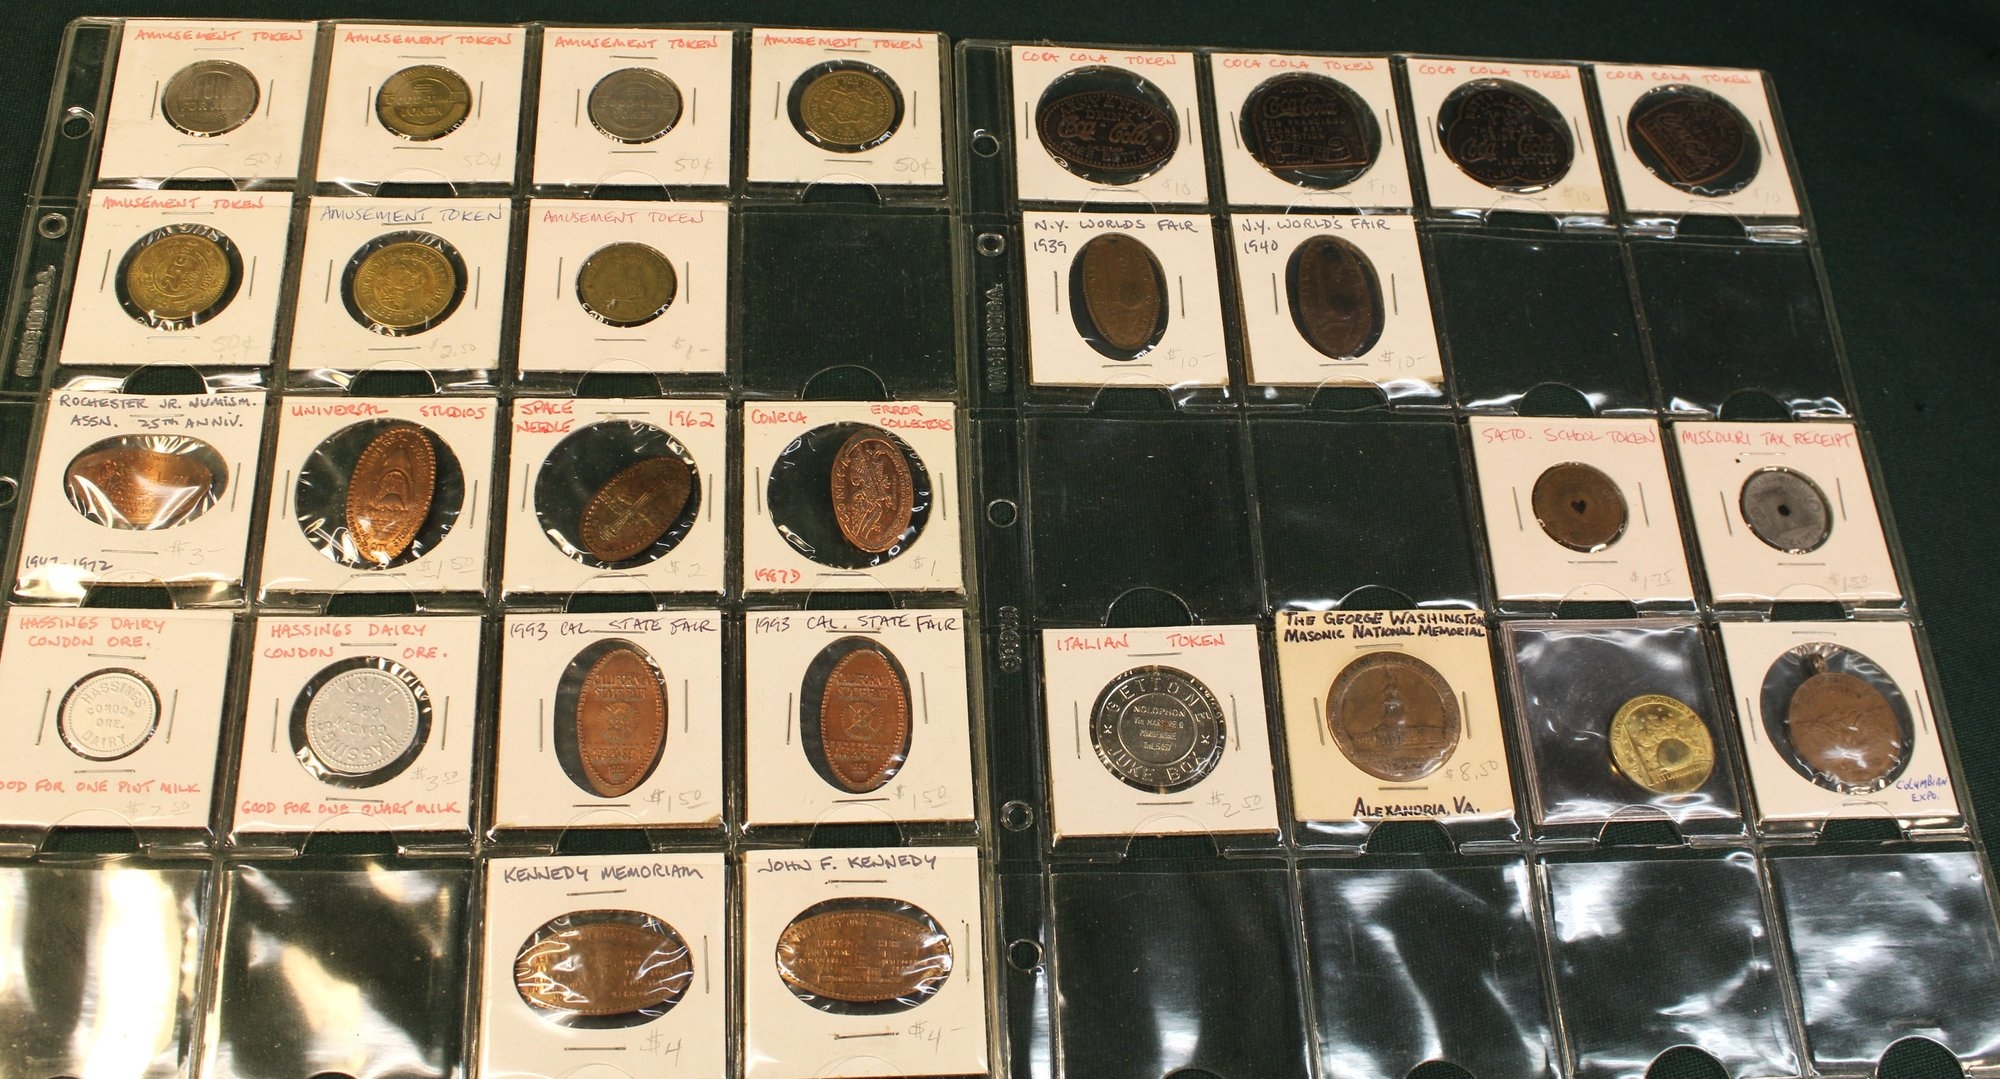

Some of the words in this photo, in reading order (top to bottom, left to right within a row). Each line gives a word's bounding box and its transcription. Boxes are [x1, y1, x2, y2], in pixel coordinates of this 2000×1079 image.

[135, 28, 241, 41] AMUSEMENT
[252, 30, 303, 41] TOKEN
[345, 32, 452, 45] AMUSEMENT
[455, 33, 512, 45] TOKEN
[555, 36, 657, 48] AMUSEMENT
[668, 35, 718, 49] TOKEN
[763, 34, 862, 48] AMUSEMENT
[869, 37, 923, 50] TOKEN
[1022, 51, 1059, 62] COCA
[1070, 52, 1108, 64] COLA
[1127, 55, 1175, 65] TOKEN
[1223, 58, 1261, 68] COCA
[1269, 59, 1309, 68] COLA
[1324, 60, 1375, 71] TOKEN
[1419, 64, 1456, 75] COCA
[1470, 66, 1510, 77] COLA
[1522, 69, 1571, 79] TOKEN
[1606, 71, 1644, 80] COCA
[1652, 73, 1690, 81] COLA
[1701, 74, 1751, 84] TOKEN
[102, 196, 200, 209] AMUSEMENT
[213, 196, 264, 209] TOKEN
[321, 206, 432, 224] AMUSEMENT
[440, 205, 501, 221] TOKEN
[543, 210, 636, 223] AMUSEMENT
[648, 210, 704, 223] TOKEN
[1034, 220, 1068, 232] N.Y.
[1080, 219, 1145, 229] WORLDS
[1157, 219, 1198, 233] FAIR
[1242, 219, 1270, 235] N.Y.
[1351, 218, 1390, 230] FAIR
[1034, 239, 1066, 253] 1939
[1244, 240, 1278, 254] 1940
[59, 394, 149, 410] ROCHESTER
[159, 399, 181, 409] JR.
[520, 400, 574, 415] SPACE
[291, 405, 388, 419] UNIVERSAL
[419, 405, 487, 420] STUDIOS
[871, 405, 923, 416] ERROR
[71, 415, 118, 428] ASSN.
[181, 414, 243, 428] ANNIV.
[515, 419, 574, 434] NEEDLE
[669, 411, 715, 428] 1962
[879, 417, 954, 431] COLLECTORS
[1544, 428, 1602, 442] SCHOOL
[1606, 427, 1655, 444] TOKEN
[1682, 430, 1751, 445] MISSOURI
[1760, 432, 1790, 447] TAX
[1793, 432, 1855, 448] RECEIPT
[20, 616, 99, 630] HASSINGS
[111, 617, 165, 634] DAIRY
[756, 617, 790, 634] 1993
[857, 614, 912, 630] STATE
[916, 615, 959, 632] FAIR
[1284, 612, 1316, 626] THE
[1323, 612, 1383, 625] GEORGE
[1390, 611, 1487, 626] WASHINGTON
[271, 623, 351, 638] HASSINGS
[368, 624, 426, 637] DAIRY
[511, 623, 548, 641] 1993
[608, 617, 663, 633] STATE
[670, 618, 717, 635] FAIR
[1284, 629, 1345, 643] MASONIC
[1353, 625, 1415, 639] NATIONAL
[1418, 626, 1486, 637] MEMORIAL
[28, 636, 93, 648] CONDON
[107, 636, 150, 647] ORE.
[1058, 633, 1129, 651] ITALIAN
[1166, 633, 1225, 648] TOKEN
[264, 647, 333, 659] CONDON
[403, 646, 447, 659] ORE.
[1107, 749, 1154, 782] JUKE
[35, 779, 65, 793] FOR
[76, 780, 108, 793] ONE
[118, 779, 155, 793] PINT
[160, 783, 200, 794] MILK
[241, 800, 276, 814] GOOD
[283, 801, 311, 815] FOR
[318, 800, 350, 814] ONE
[359, 799, 412, 816] QUART
[416, 802, 461, 814] MILK
[1453, 796, 1480, 814] VA.
[758, 858, 812, 873] JOHN
[820, 856, 837, 870] F.
[847, 855, 936, 870] KENNEDY
[504, 866, 588, 883] KENNEDY
[601, 863, 703, 880] MEMORIAM
